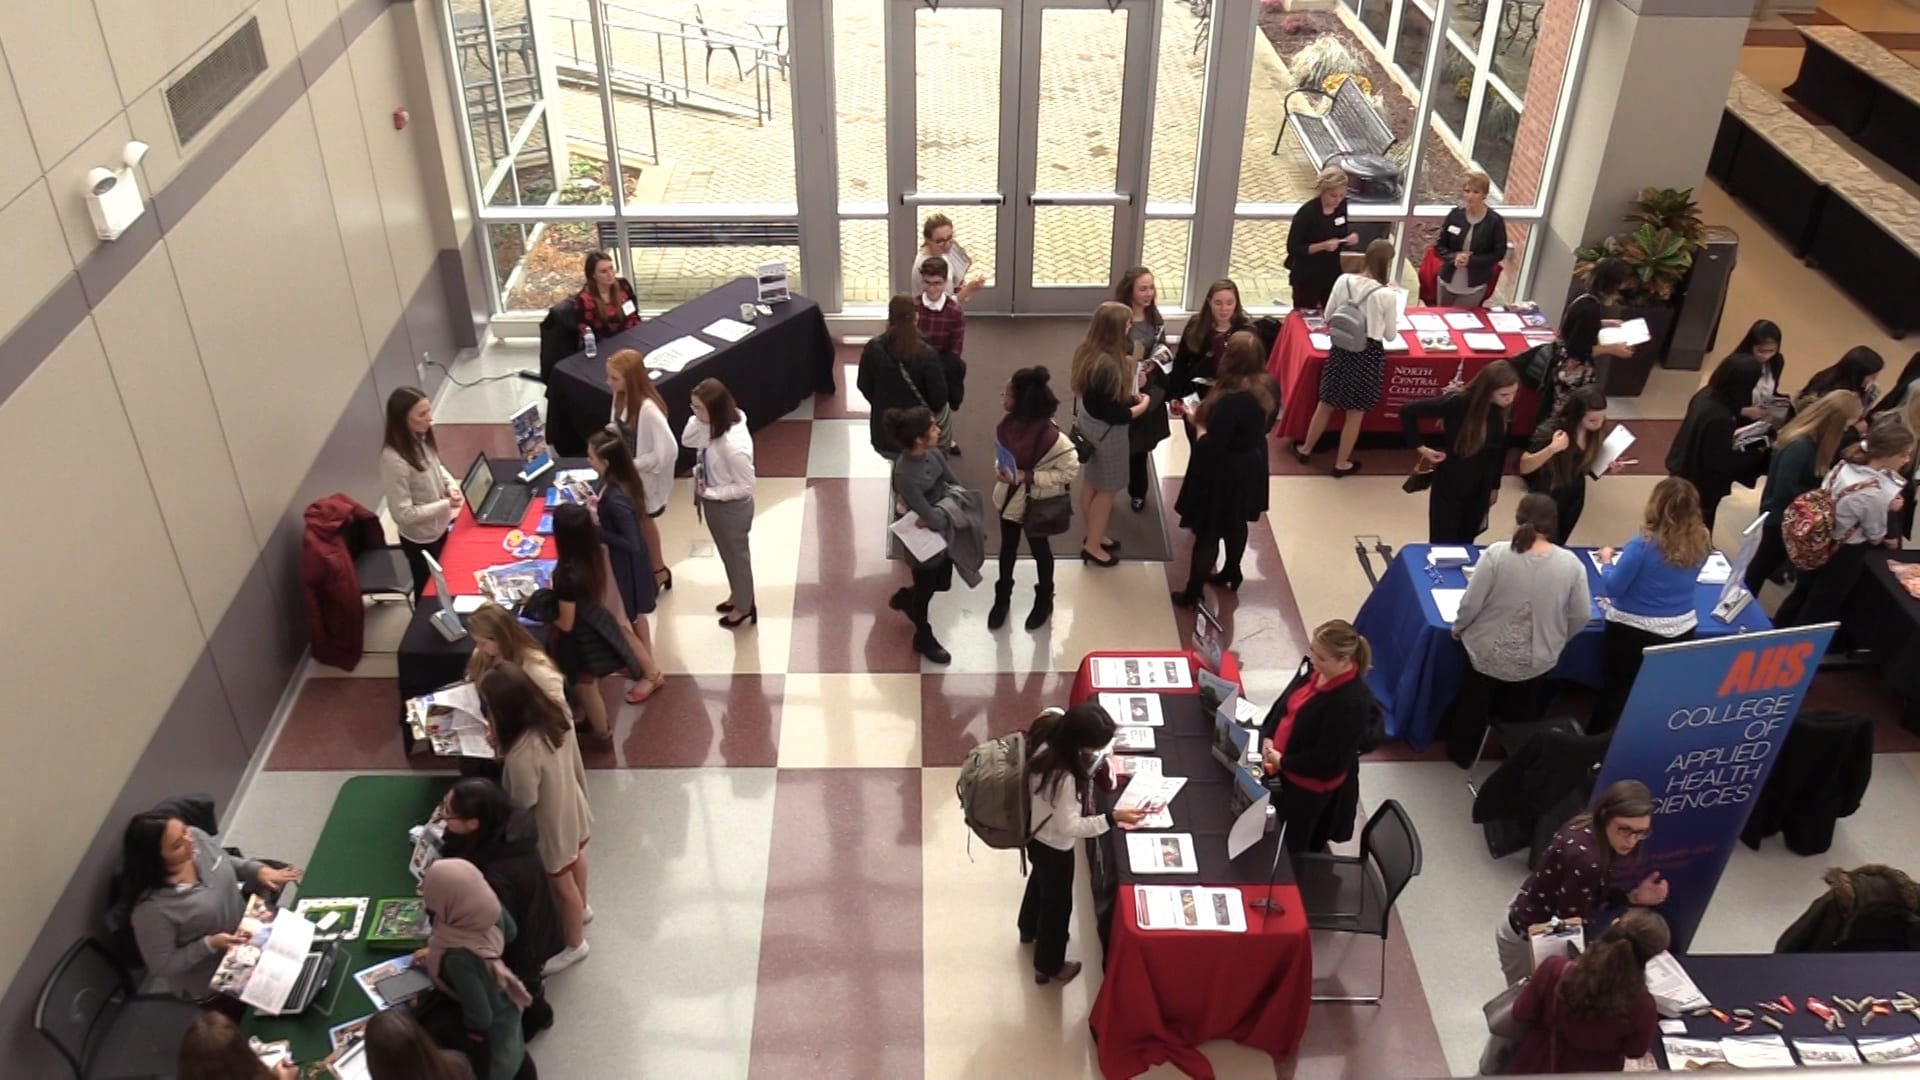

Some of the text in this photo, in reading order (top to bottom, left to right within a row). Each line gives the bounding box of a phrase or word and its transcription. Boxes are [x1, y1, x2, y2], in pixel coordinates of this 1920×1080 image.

[1391, 375, 1440, 386] CENTRAL
[1394, 365, 1433, 376] NORTH
[1388, 385, 1438, 396] COLLEGE
[1716, 642, 1815, 698] AHS
[1667, 693, 1795, 730] COLLEGE
[1744, 717, 1785, 740] OF
[1665, 740, 1772, 773] APPLIED
[1665, 763, 1762, 794] HEALTH
[1652, 783, 1753, 814] CIENCES
